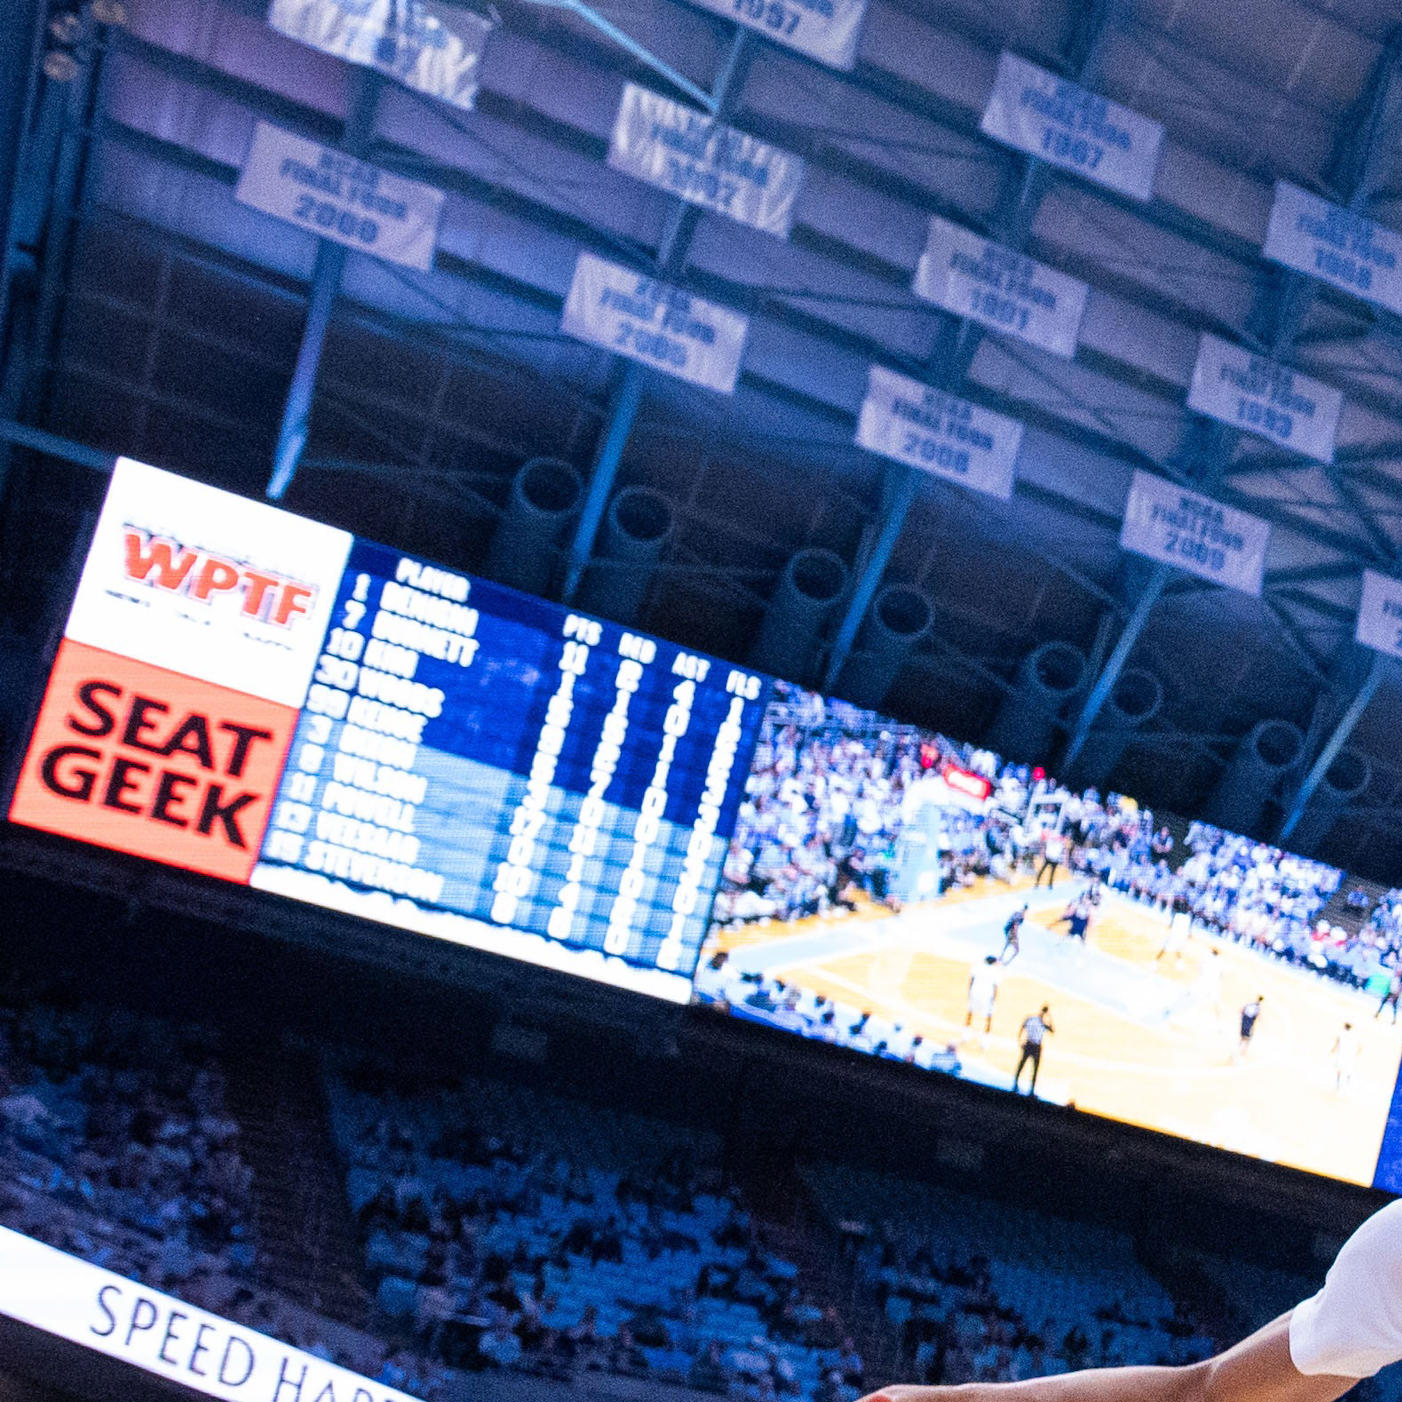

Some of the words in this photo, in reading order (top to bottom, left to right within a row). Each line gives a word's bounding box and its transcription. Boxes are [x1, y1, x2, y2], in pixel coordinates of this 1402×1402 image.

[125, 533, 312, 625] WPTF
[66, 679, 273, 780] SEAT
[42, 744, 261, 849] GEEK
[89, 1283, 256, 1389] SPEED
